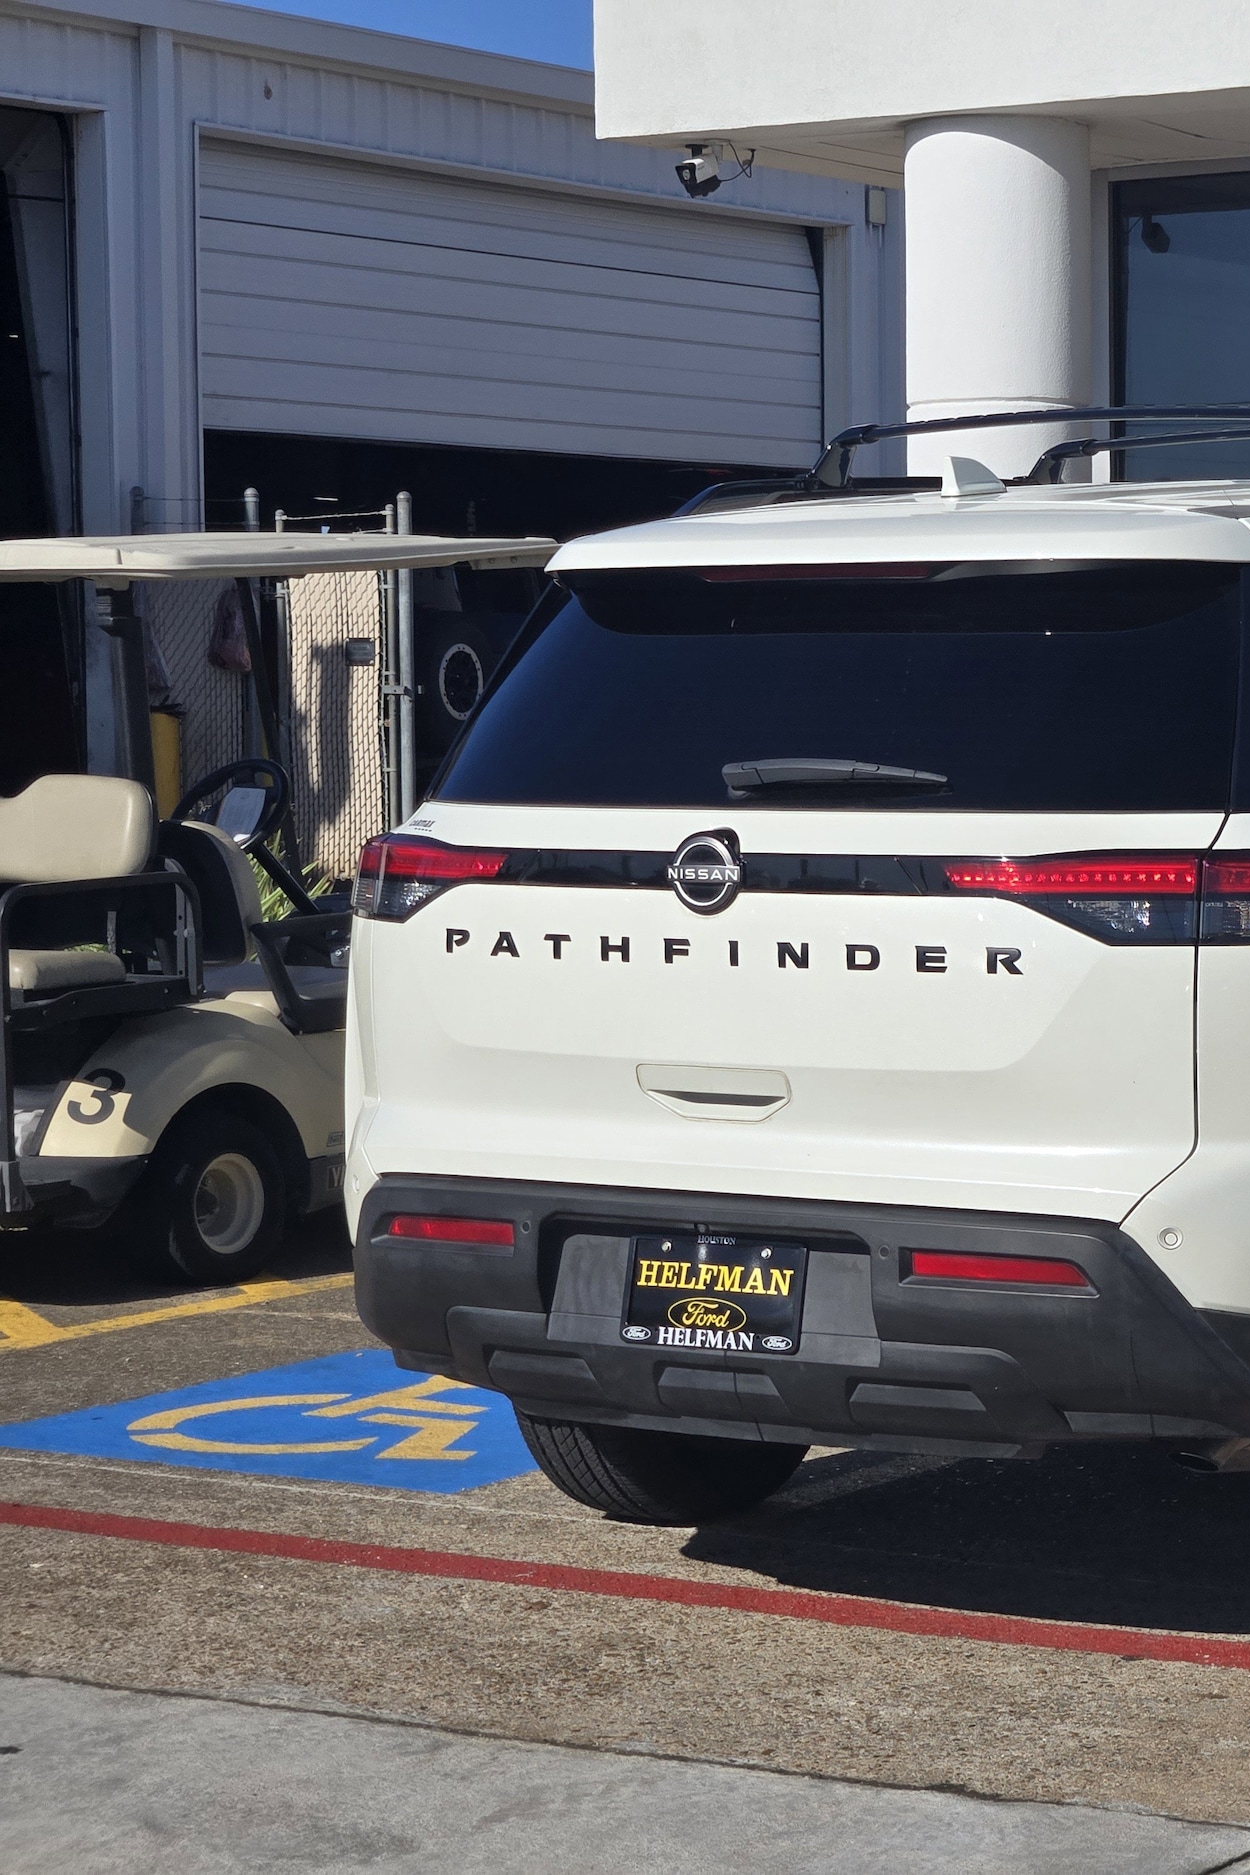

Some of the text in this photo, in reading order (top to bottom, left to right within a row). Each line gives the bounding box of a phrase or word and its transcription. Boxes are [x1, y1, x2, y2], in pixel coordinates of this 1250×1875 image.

[668, 867, 739, 881] NISSAN
[446, 928, 1024, 975] PATHFINDER
[67, 1068, 126, 1125] 3
[697, 1235, 737, 1245] HOUSTON
[637, 1259, 794, 1296] HELFMAN
[682, 1300, 731, 1328] Ford
[657, 1326, 755, 1351] HELFMAN
